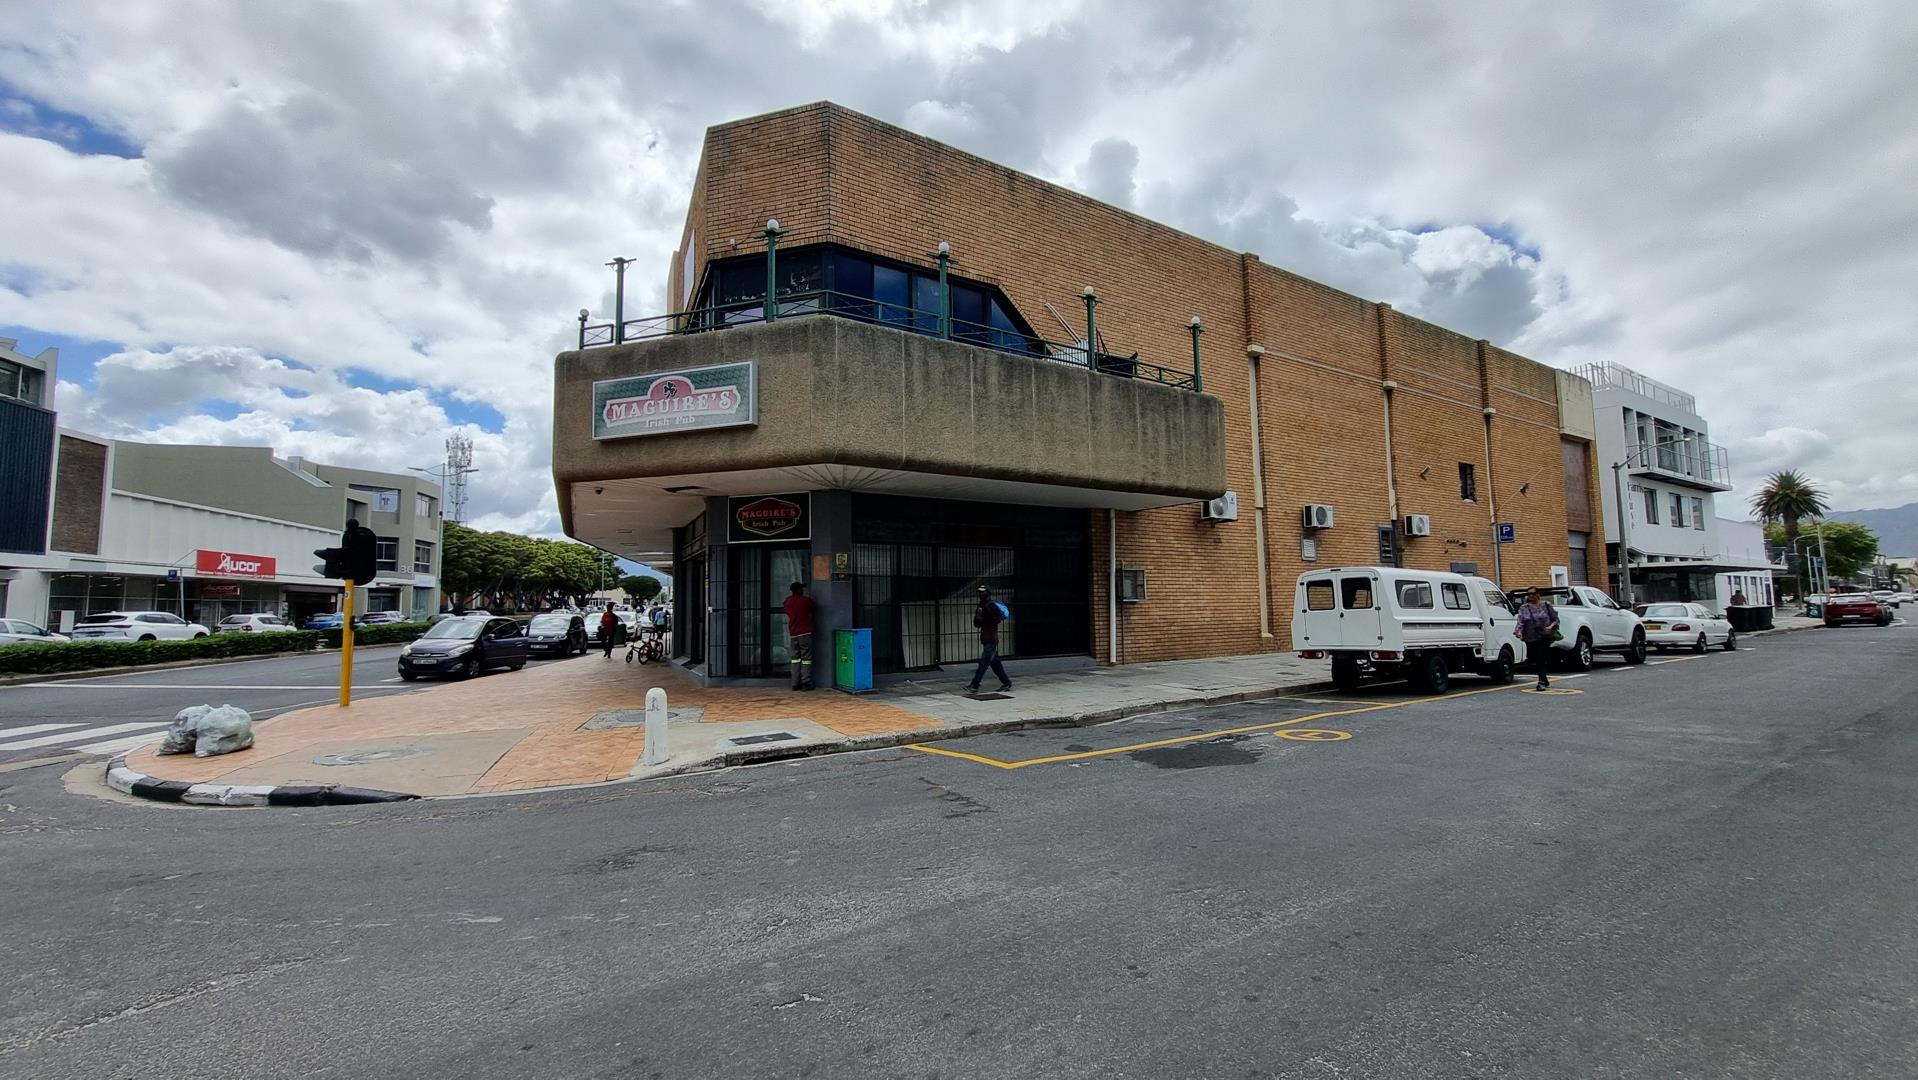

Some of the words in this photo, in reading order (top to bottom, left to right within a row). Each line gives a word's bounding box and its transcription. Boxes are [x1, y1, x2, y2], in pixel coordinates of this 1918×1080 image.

[611, 390, 732, 421] MAGUIRE'S
[645, 416, 670, 428] Irish
[675, 415, 695, 425] Pub
[741, 508, 796, 519] MAGUIRE'S
[1502, 526, 1511, 534] P
[400, 564, 414, 573] 36
